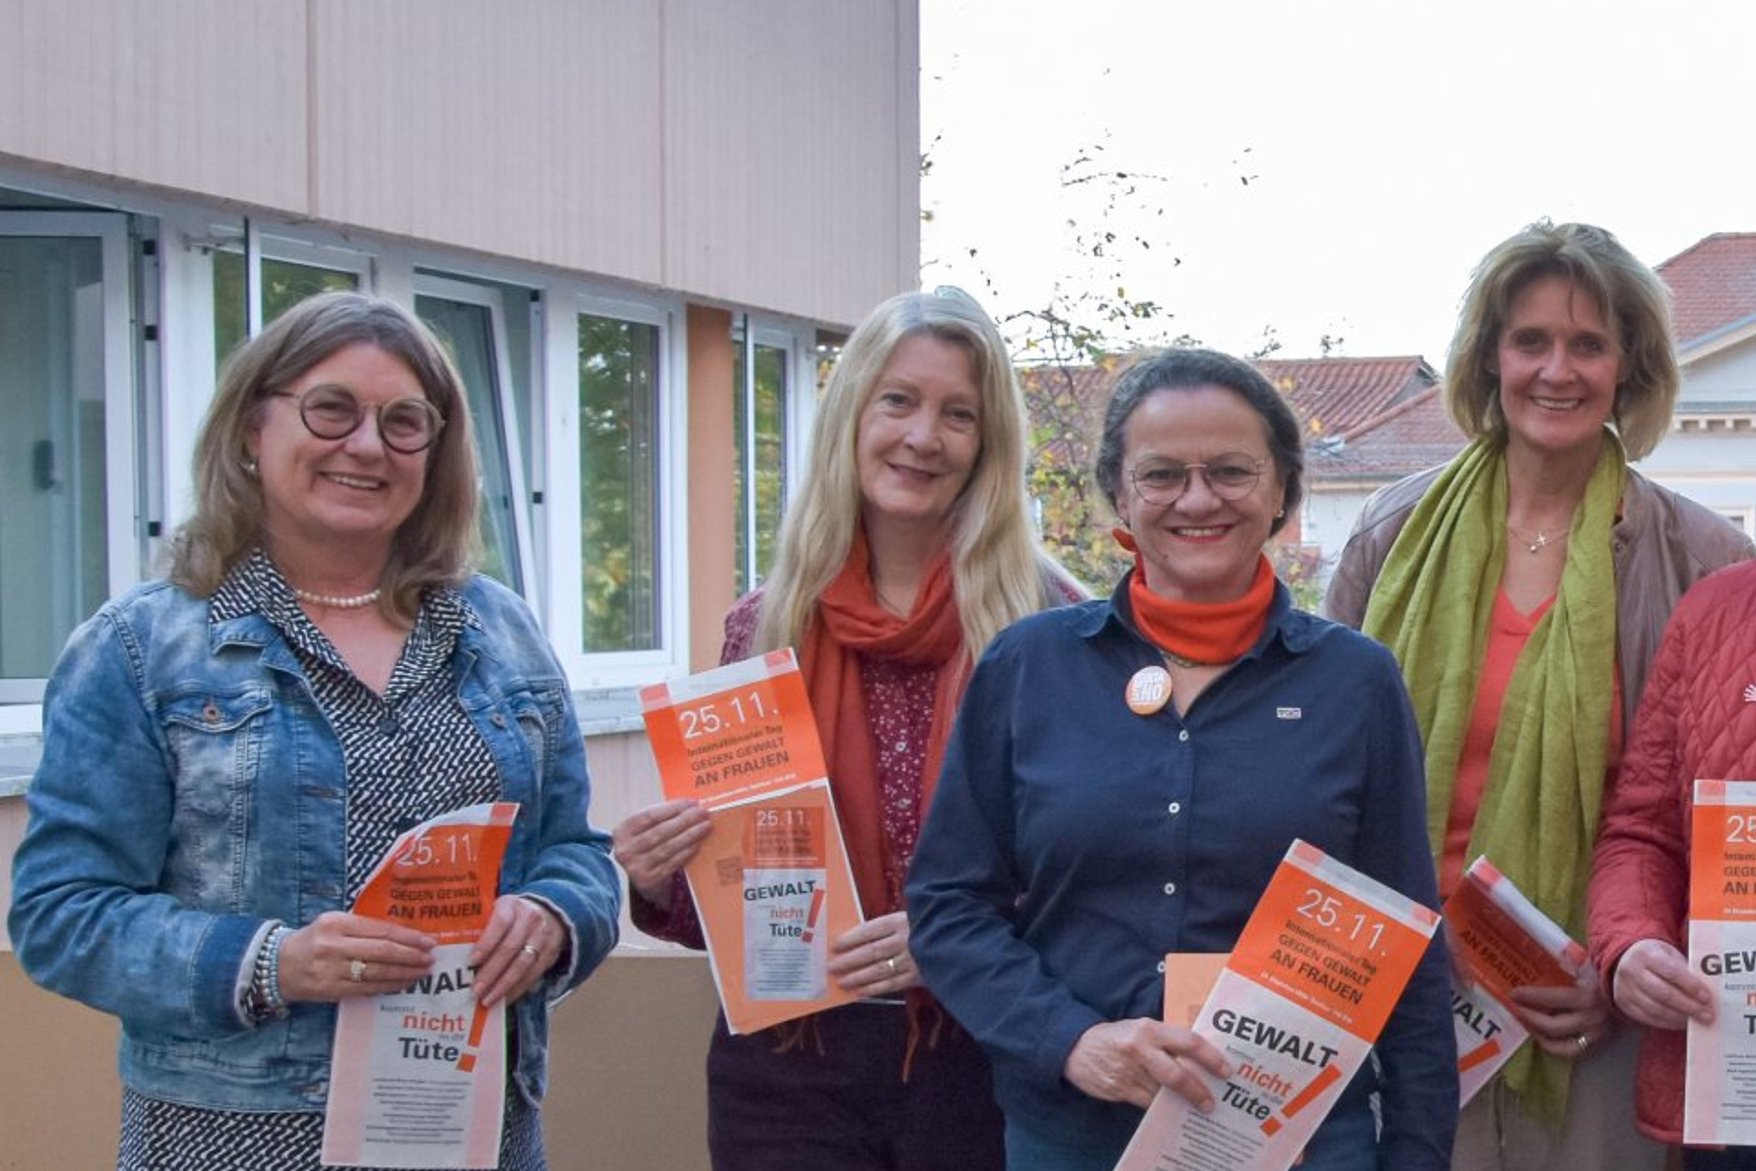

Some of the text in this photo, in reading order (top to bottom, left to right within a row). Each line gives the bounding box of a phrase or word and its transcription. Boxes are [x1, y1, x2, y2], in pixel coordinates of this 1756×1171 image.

[679, 691, 778, 739] 25.11.
[691, 737, 784, 772] GEGEN GEWALT
[695, 751, 789, 788] AN FRAUEN
[396, 833, 478, 866] 25.11.
[743, 880, 816, 901] GEWALT
[1723, 881, 1749, 895] AN
[388, 902, 482, 919] AN FRAUEN
[1296, 888, 1387, 957] 25.11.
[1270, 948, 1297, 969] AN
[1298, 962, 1364, 1005] FRAUEN
[1278, 934, 1372, 986] GEGEN GEWALT
[1481, 946, 1523, 987] FRAUE
[403, 1011, 465, 1032] nicht
[1212, 1009, 1339, 1069] GEWALT
[398, 1037, 460, 1062] Tüte
[1237, 1063, 1294, 1097] nicht
[1221, 1081, 1271, 1121] Tüte
